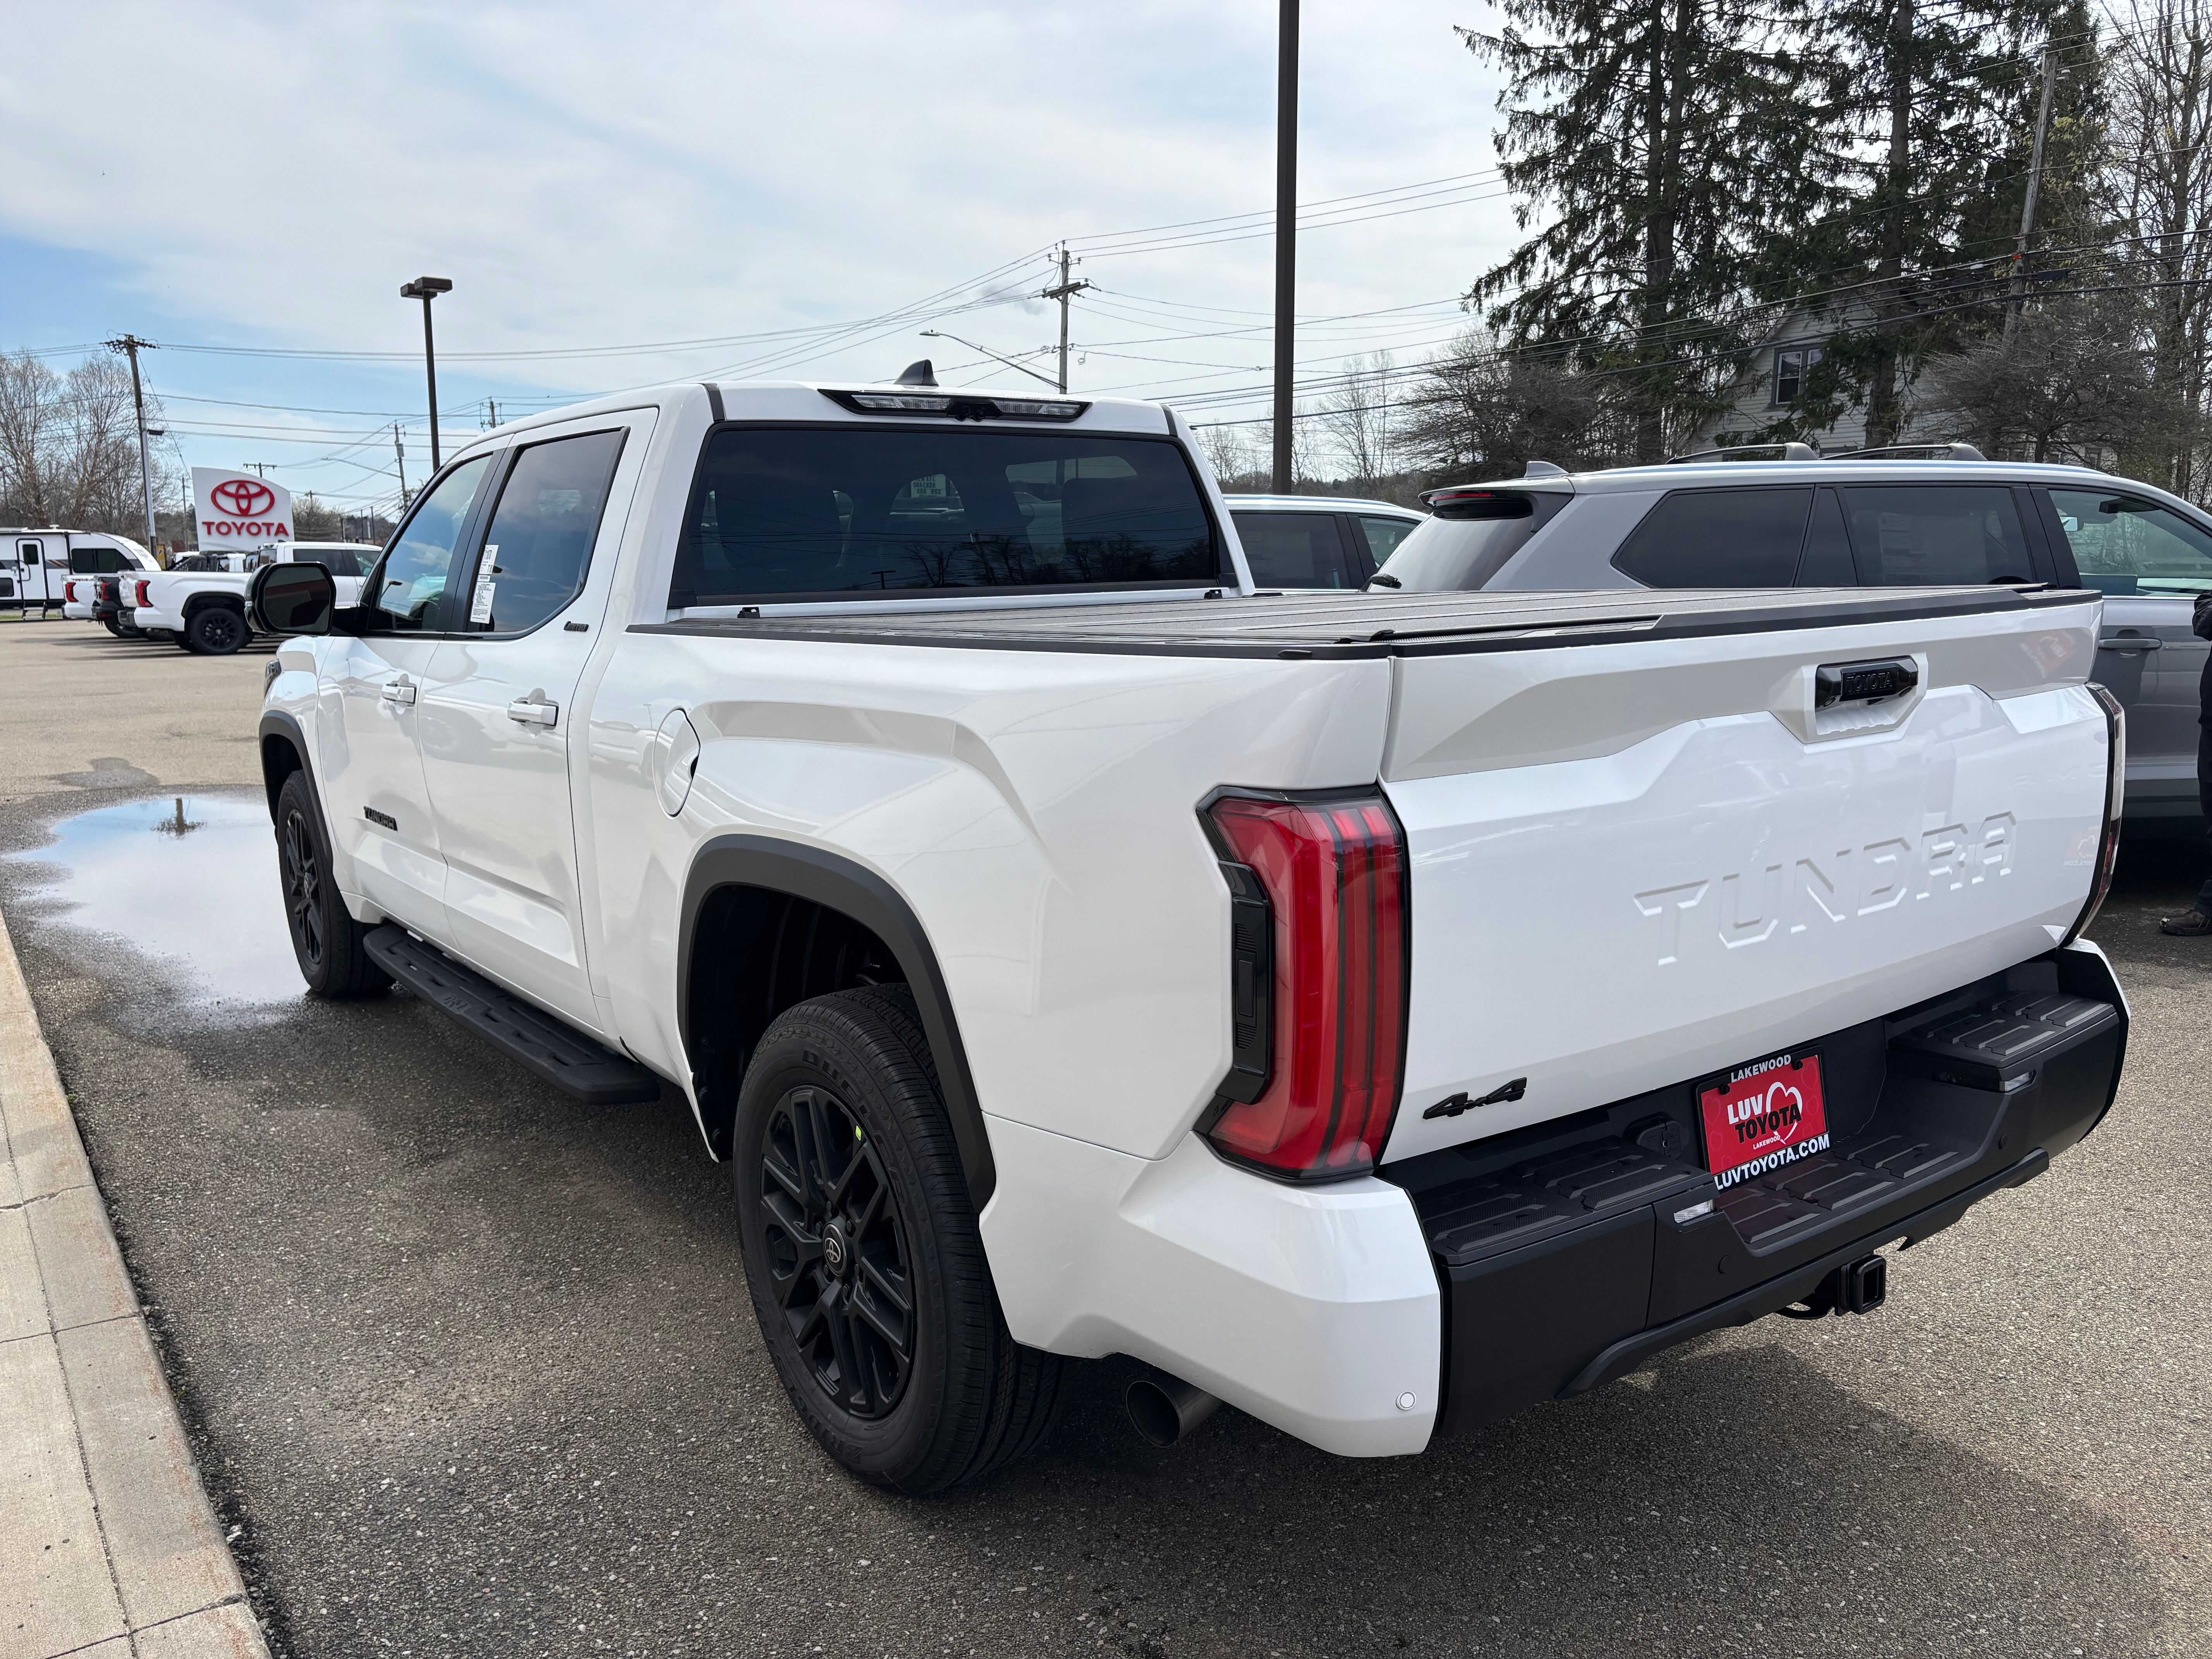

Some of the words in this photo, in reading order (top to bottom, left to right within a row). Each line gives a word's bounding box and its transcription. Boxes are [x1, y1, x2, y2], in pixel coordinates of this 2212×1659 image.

[202, 521, 289, 537] TOYOTA
[1846, 672, 1893, 693] TOYOTA
[363, 805, 398, 831] TUNDRA
[1633, 810, 2017, 966] TUNDRA
[1731, 1054, 1791, 1083] LAKEWOOD
[1727, 1093, 1763, 1125] LUV
[1735, 1103, 1802, 1144] TOYOTA
[1753, 1135, 1781, 1150] LAKEWOOD
[1714, 1133, 1830, 1190] LUVTOYOTA.COM
